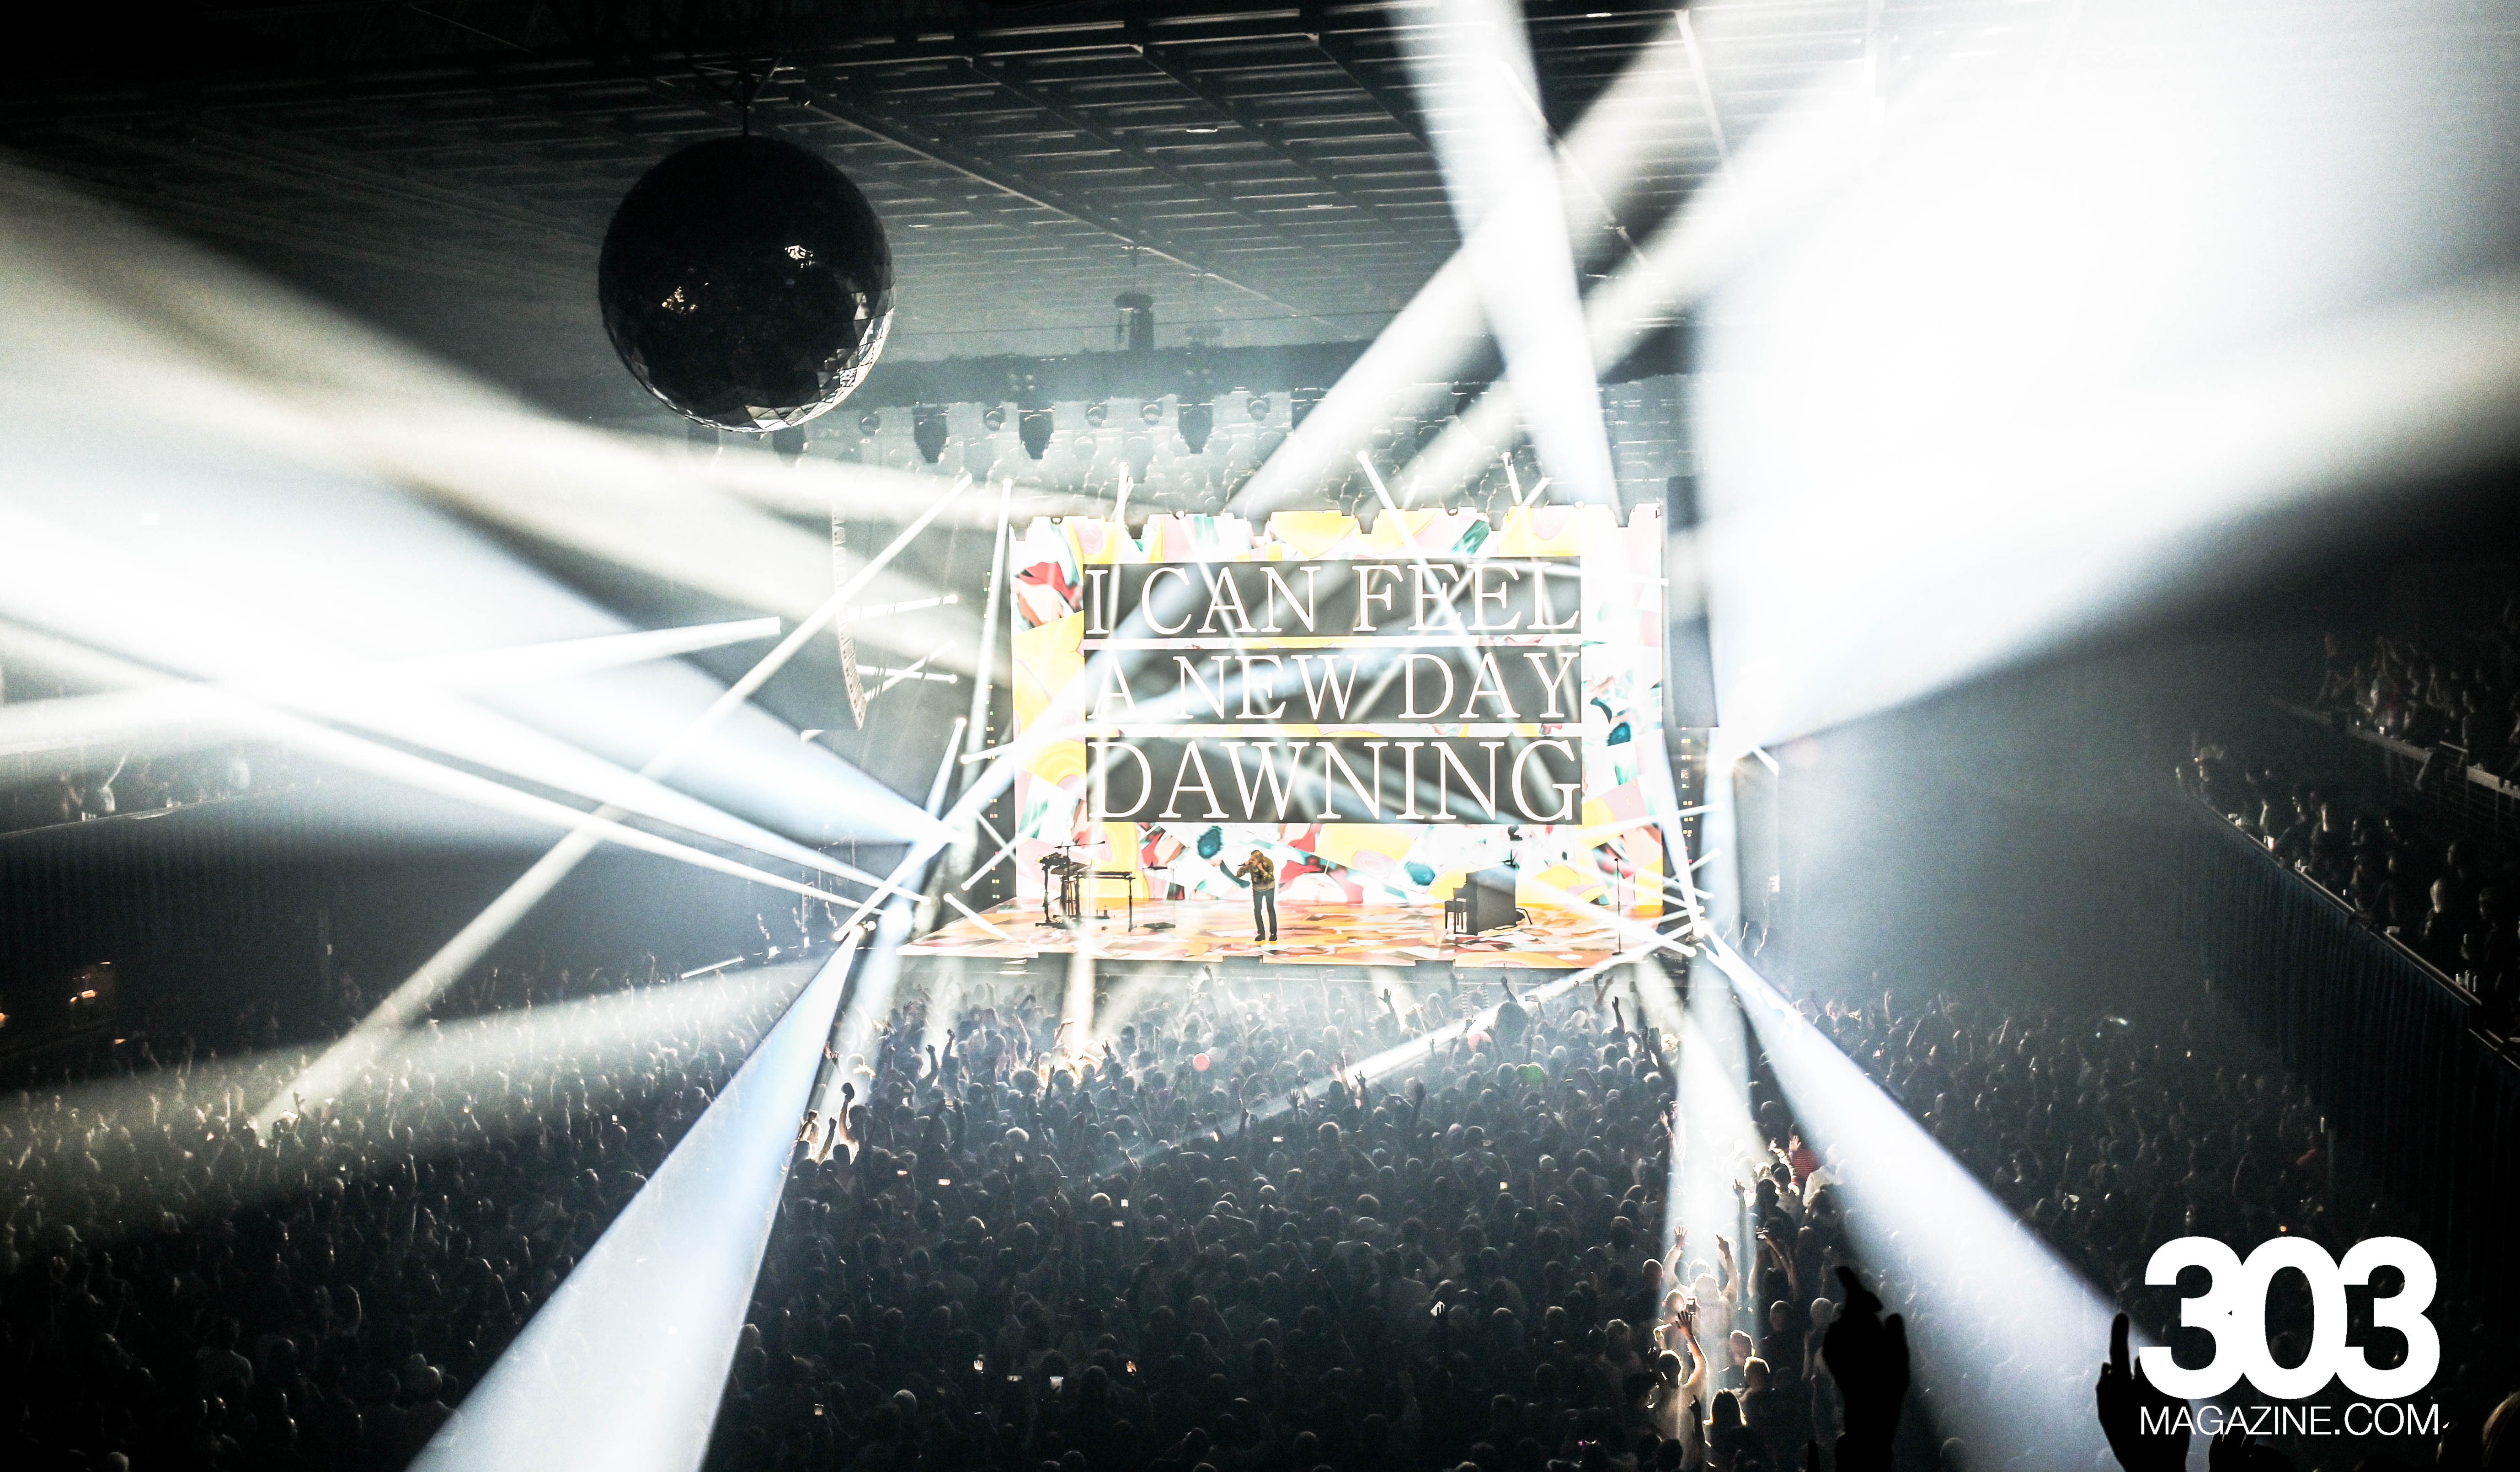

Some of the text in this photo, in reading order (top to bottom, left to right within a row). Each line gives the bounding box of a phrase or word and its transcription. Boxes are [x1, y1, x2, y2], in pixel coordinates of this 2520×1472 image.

[1085, 561, 1580, 635] I CAN FEEL
[1087, 652, 1580, 720] A NEW DAY
[1087, 739, 1581, 821] DAWNING
